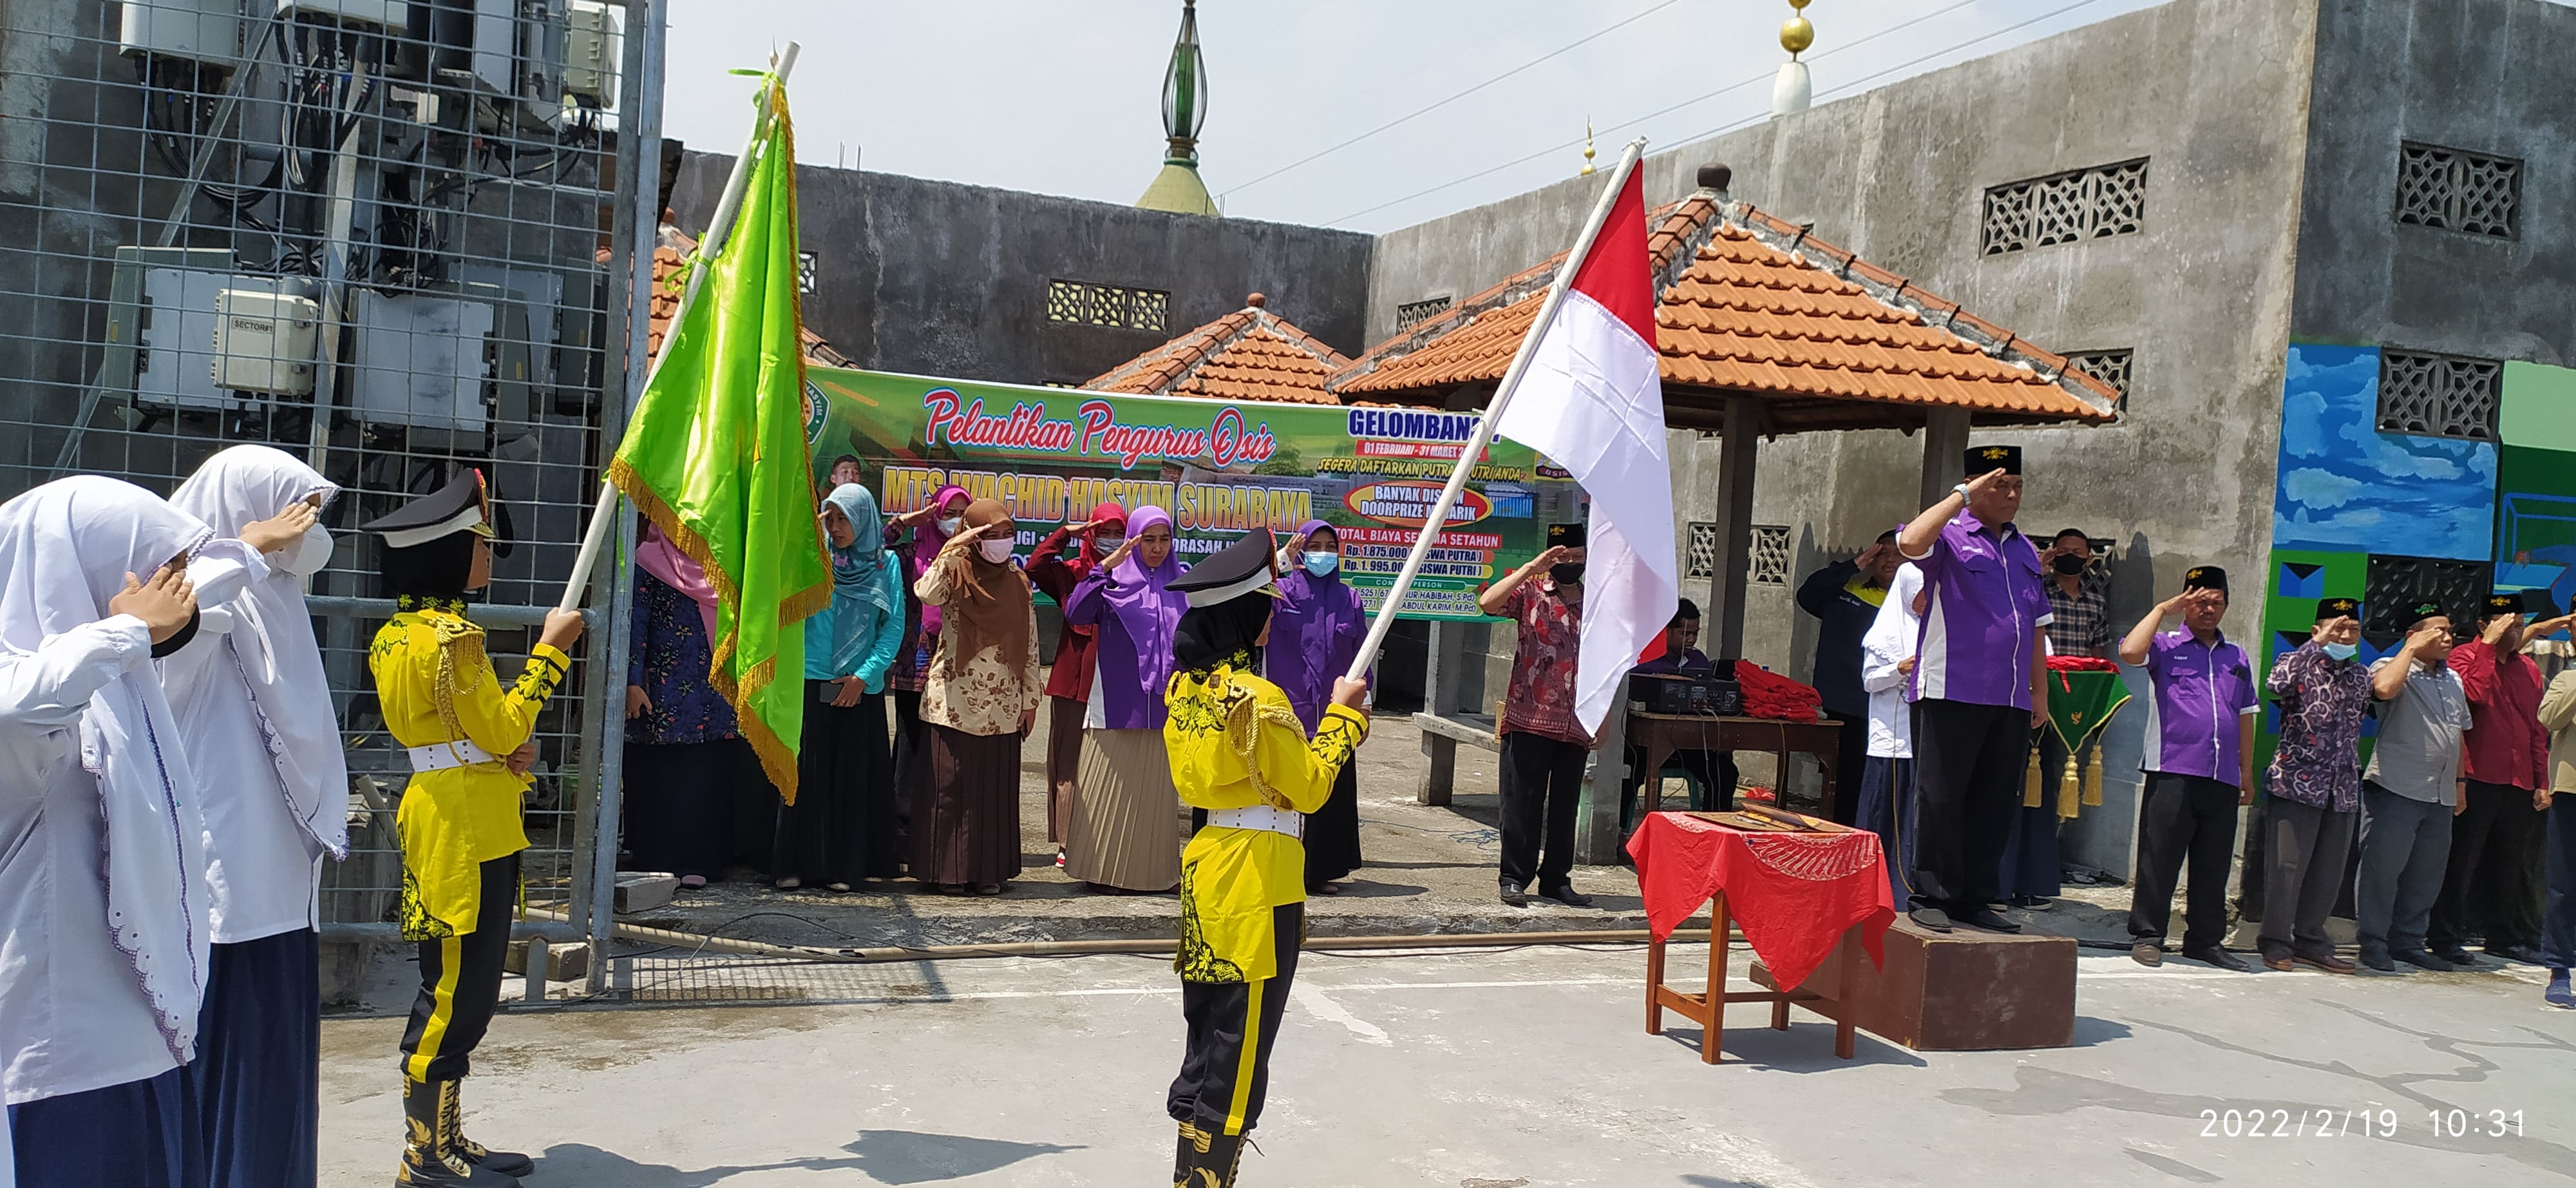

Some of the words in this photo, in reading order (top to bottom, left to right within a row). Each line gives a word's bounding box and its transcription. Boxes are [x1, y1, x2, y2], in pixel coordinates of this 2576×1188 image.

[923, 387, 1076, 452] Pelantikan
[1079, 399, 1209, 470] Pengurus
[1209, 407, 1276, 468] Osis
[1364, 442, 1374, 454] 01
[1375, 443, 1415, 455] FEBRUARI
[1419, 445, 1430, 456] 31
[1430, 445, 1459, 457] MARET
[1318, 458, 1358, 473] SEGERA
[1359, 459, 1421, 477] DAFTARKAN
[1422, 463, 1455, 479] PUTRA
[1470, 465, 1494, 481] UTRI
[1494, 466, 1521, 483] ANDA
[883, 466, 946, 515] MTS
[1068, 477, 1174, 526] HASYIM
[1178, 483, 1314, 533] SURABAYA
[1375, 485, 1420, 502] BANYAK
[1361, 500, 1423, 518] DOORPRIZE
[1336, 528, 1365, 541] TOTAL
[1370, 531, 1401, 542] BIAYA
[1450, 535, 1499, 547] SETAHUN
[1345, 545, 1361, 557] Rp.
[1363, 546, 1407, 559] 1.875.000
[1448, 550, 1476, 562] PUTRA
[1344, 559, 1359, 571] Rp.
[1452, 564, 1476, 576] PUTRI
